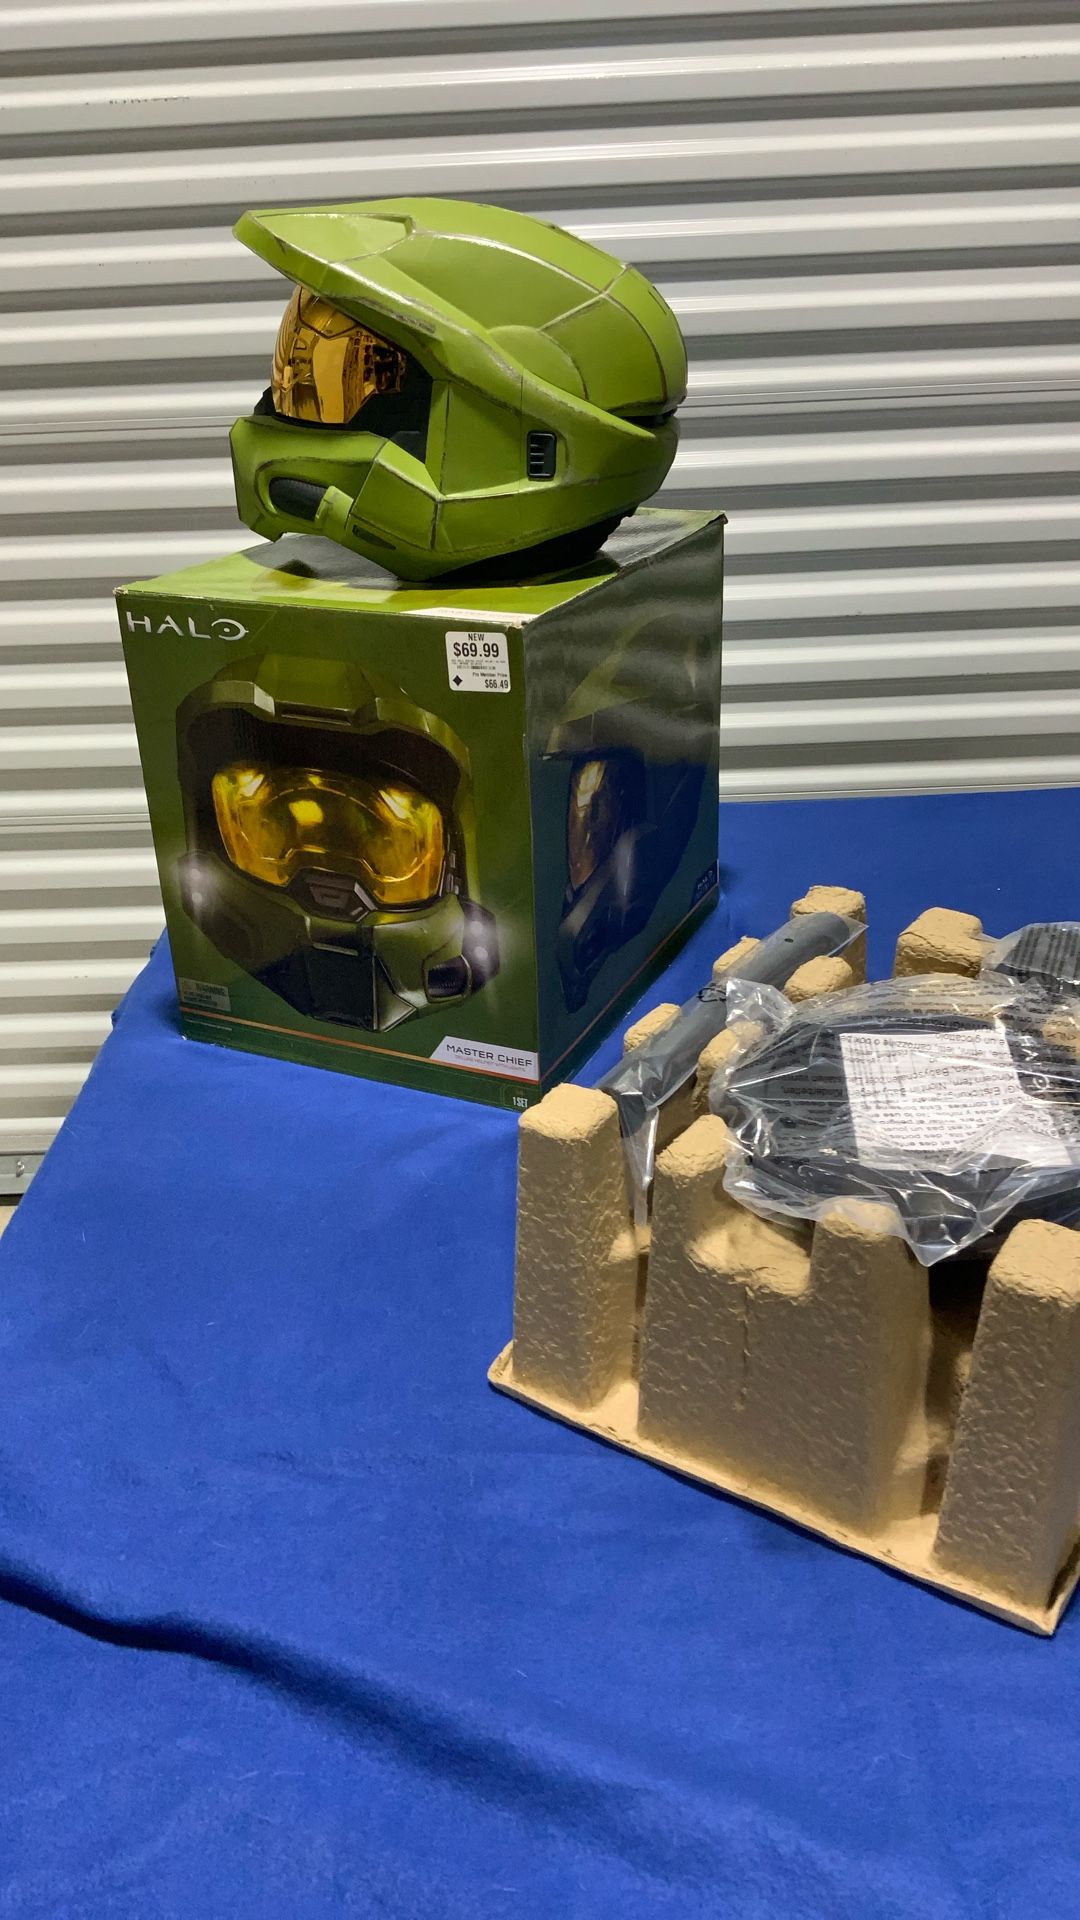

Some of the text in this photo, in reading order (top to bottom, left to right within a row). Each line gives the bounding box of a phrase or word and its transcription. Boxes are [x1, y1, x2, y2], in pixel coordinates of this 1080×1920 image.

[126, 611, 249, 641] HALO
[468, 633, 485, 641] NEW
[453, 642, 500, 658] $69.99
[484, 679, 509, 689] $66.49
[446, 1044, 533, 1067] MASTER CHIEF
[517, 1098, 528, 1108] SET
